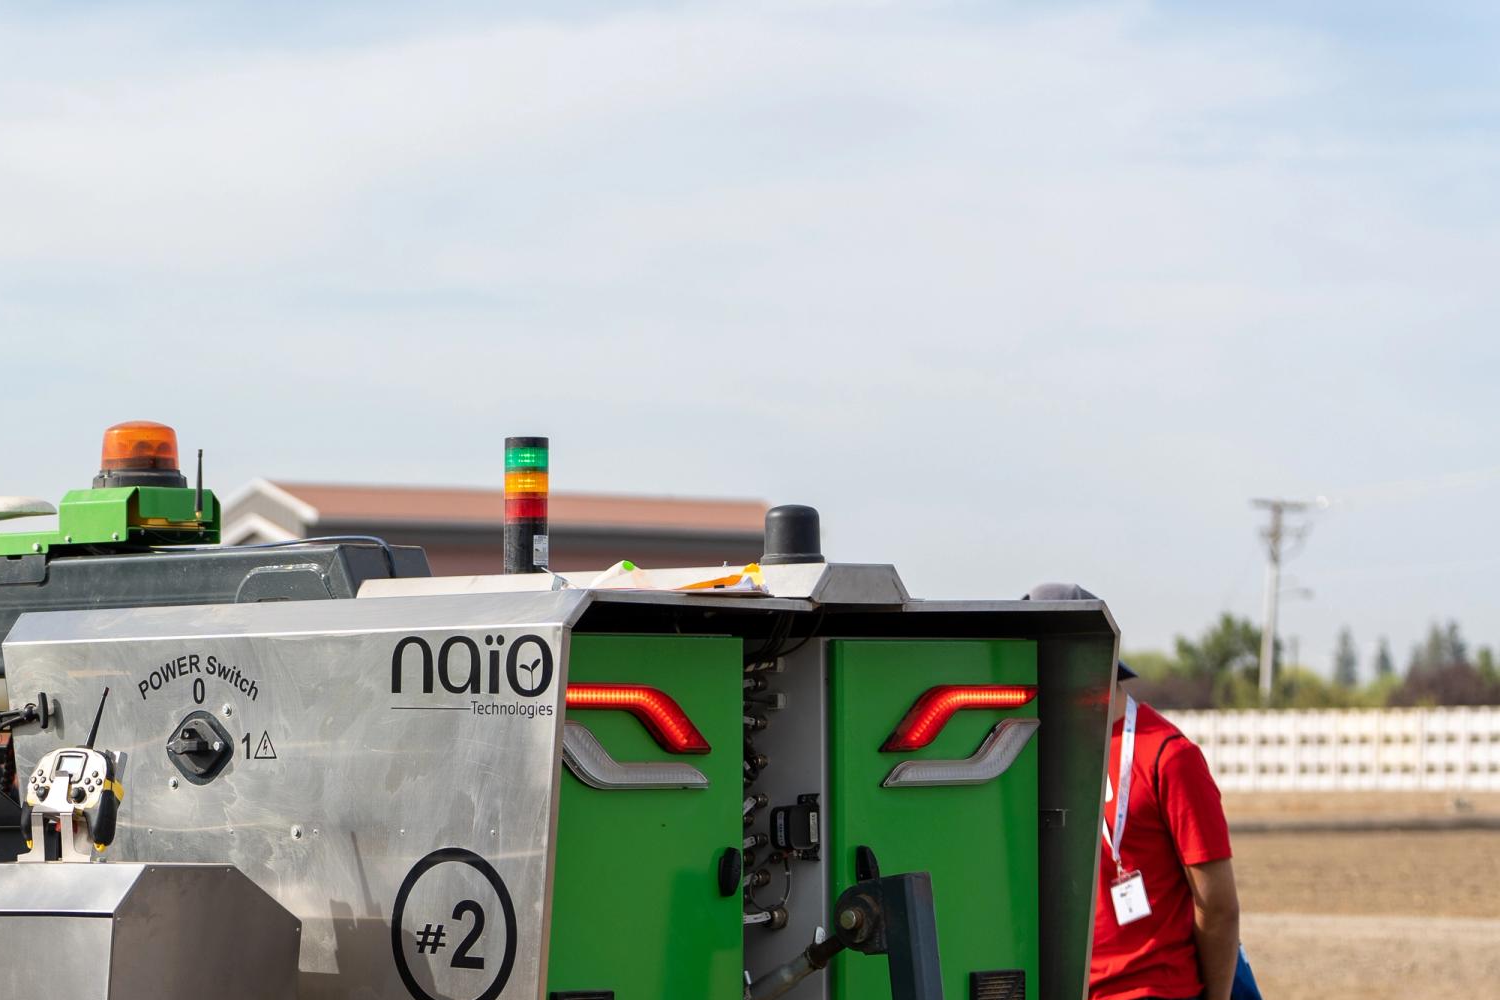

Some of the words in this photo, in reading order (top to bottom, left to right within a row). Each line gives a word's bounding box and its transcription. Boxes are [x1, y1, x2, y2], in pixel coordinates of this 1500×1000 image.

[138, 654, 201, 700] POWER
[206, 656, 259, 701] Switch
[391, 634, 554, 698] naïo
[470, 700, 553, 719] Technologies
[241, 732, 251, 760] 1
[416, 900, 486, 970] #2
